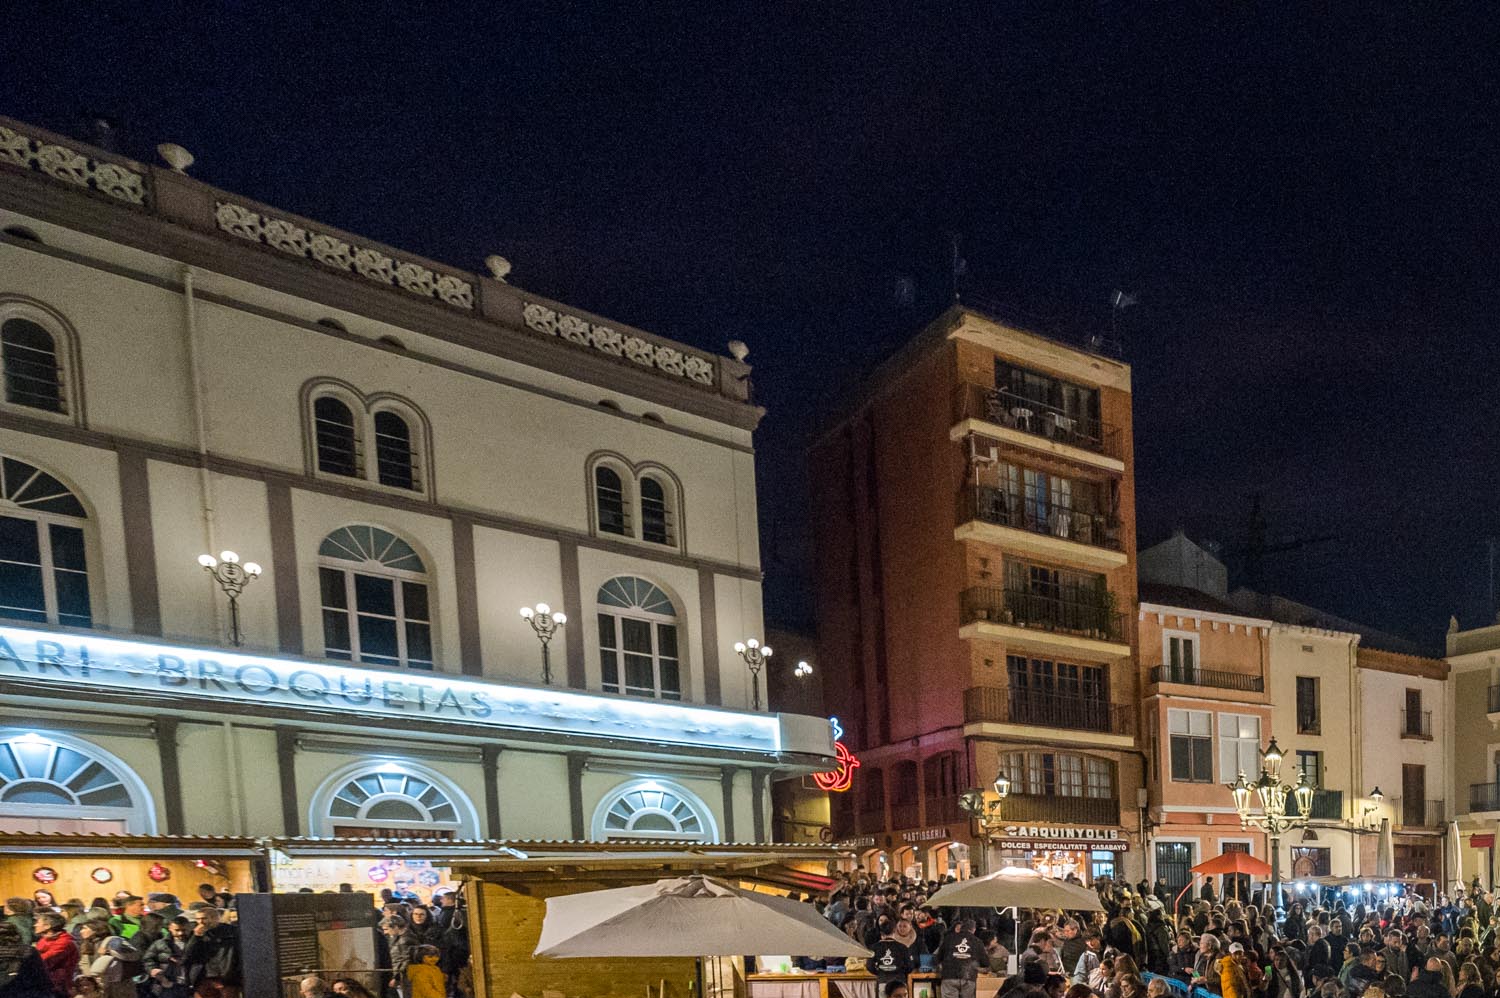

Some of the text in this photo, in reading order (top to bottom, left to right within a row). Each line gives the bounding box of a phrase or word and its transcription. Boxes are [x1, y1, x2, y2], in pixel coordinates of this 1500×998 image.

[156, 653, 493, 719] BROQUETAS
[902, 828, 946, 842] PASTISSERIA
[1001, 841, 1031, 849] DOLCES
[1033, 842, 1088, 851] ESPECIALITATS
